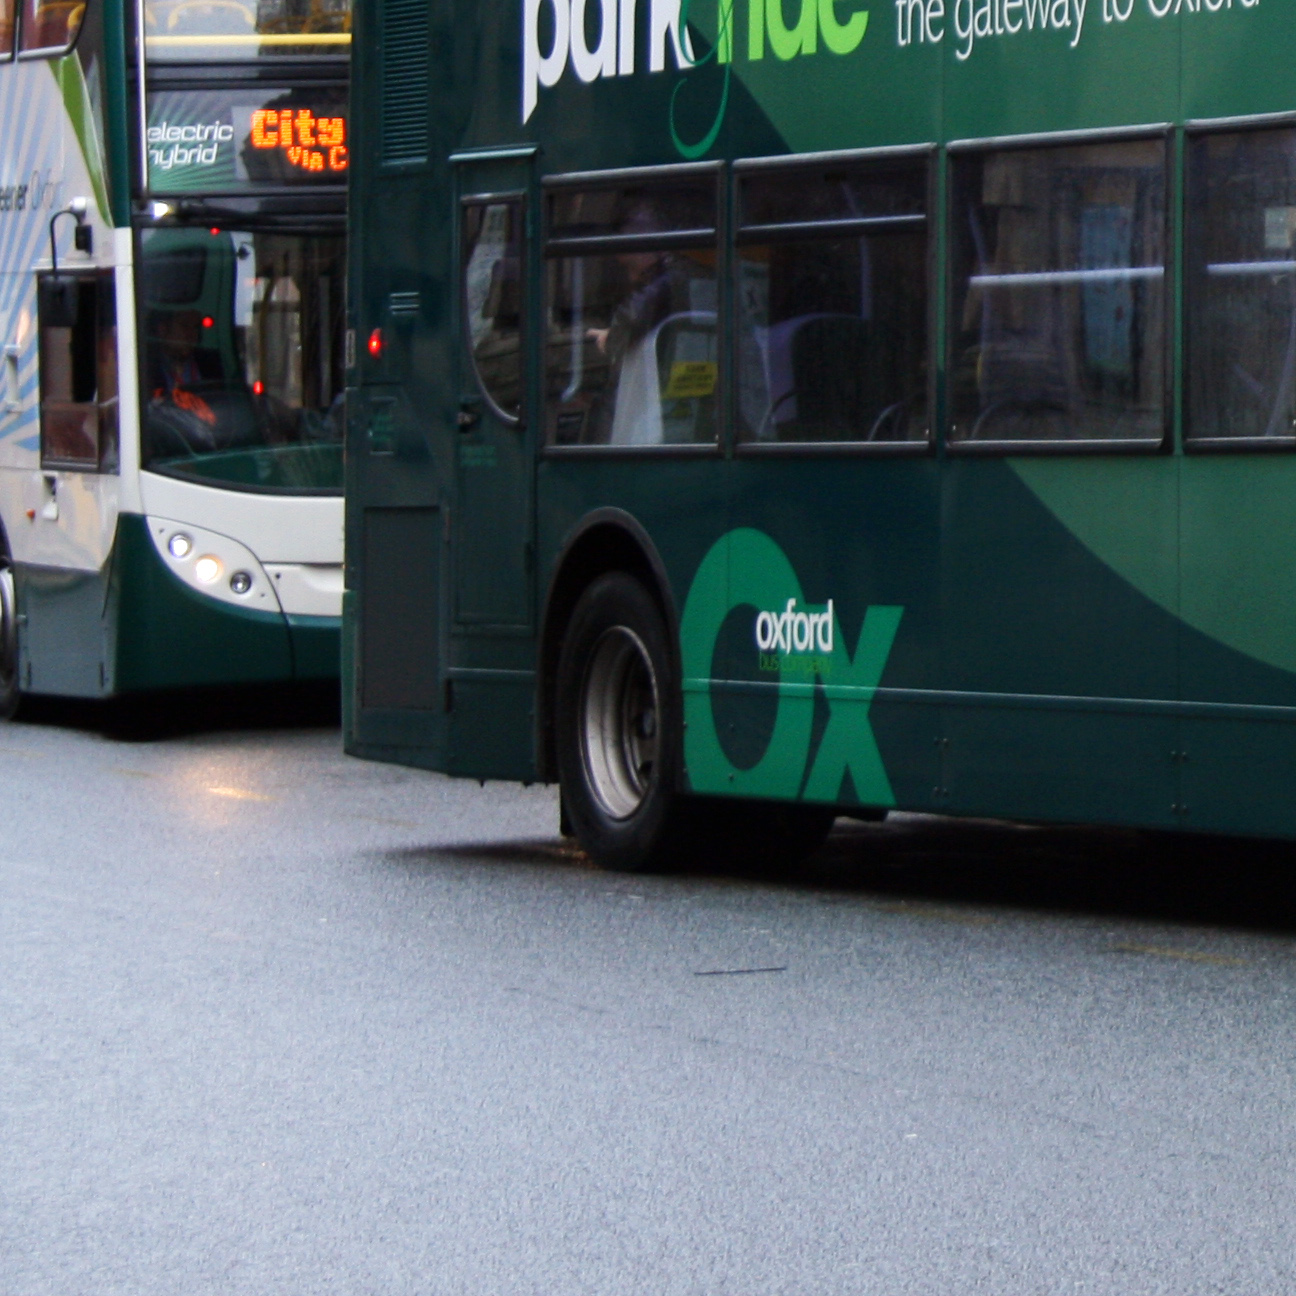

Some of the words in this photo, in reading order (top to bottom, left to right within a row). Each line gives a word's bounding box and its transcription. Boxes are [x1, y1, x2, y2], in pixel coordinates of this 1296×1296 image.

[148, 121, 234, 142] electric
[252, 109, 345, 148] City
[756, 597, 833, 654] oxford
